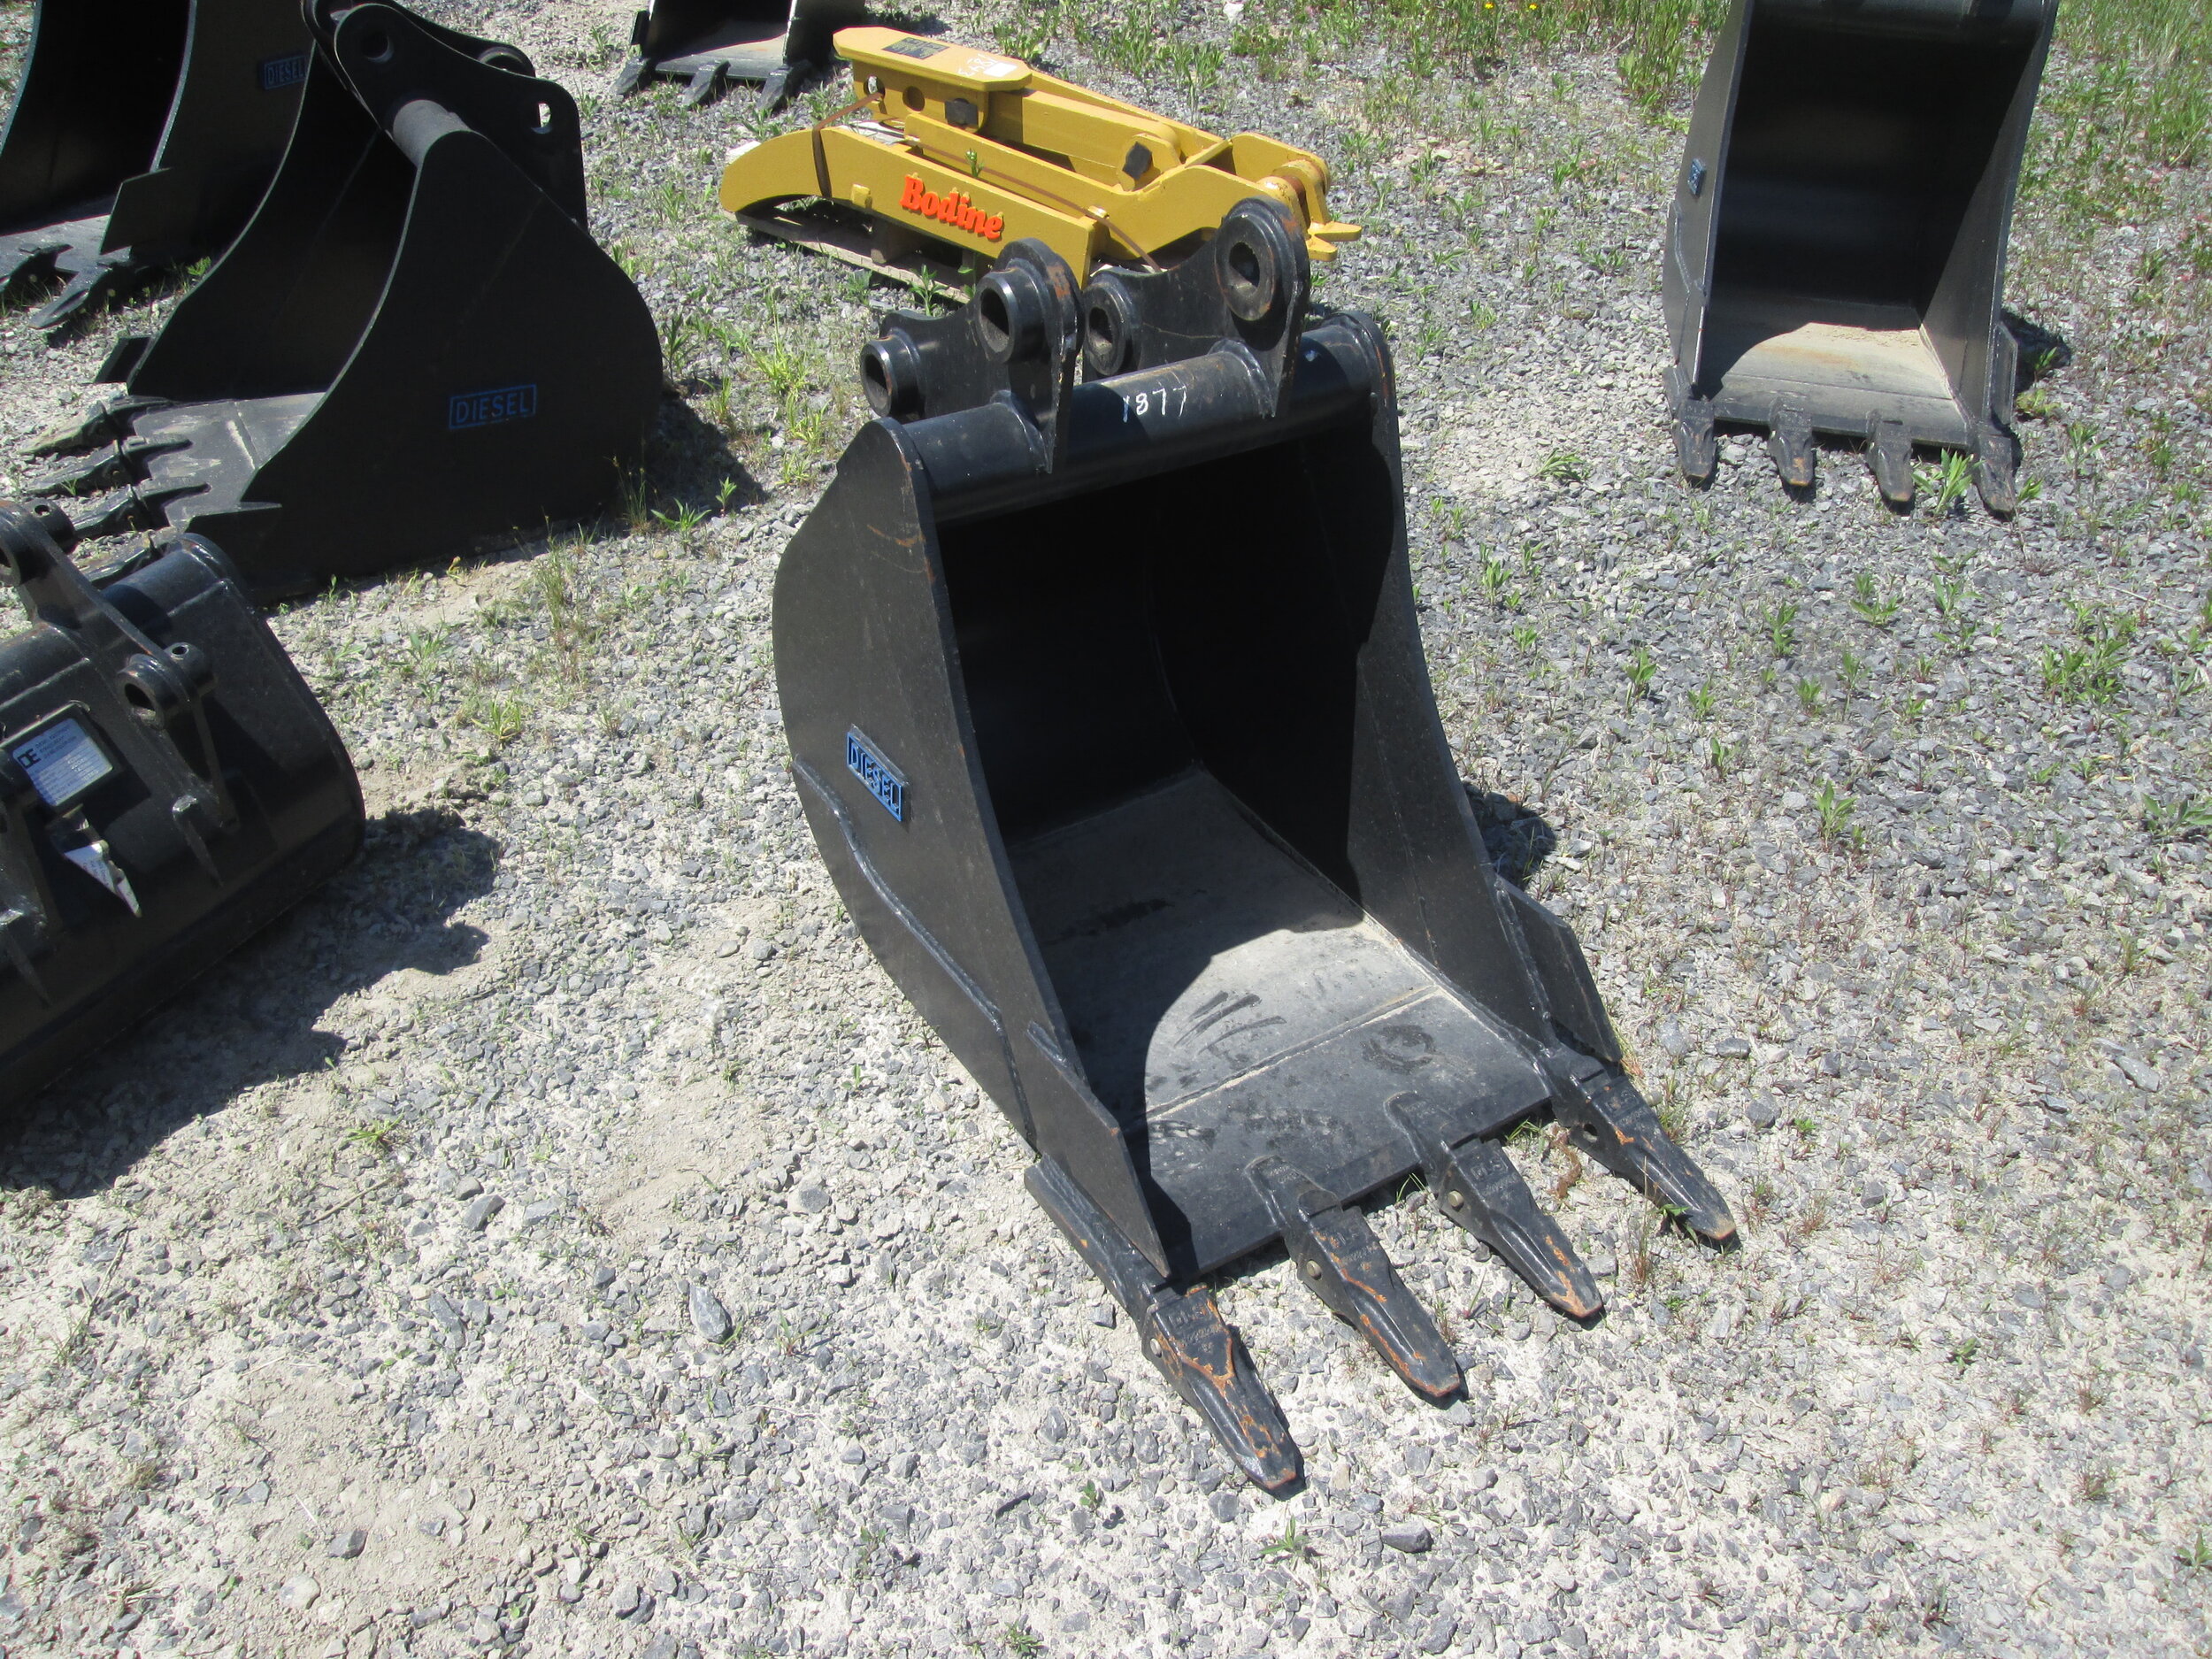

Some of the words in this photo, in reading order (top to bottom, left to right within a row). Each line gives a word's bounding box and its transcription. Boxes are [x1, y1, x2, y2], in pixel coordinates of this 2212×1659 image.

[267, 61, 306, 85] DIESEL
[899, 173, 1004, 239] Bodine
[456, 391, 529, 424] DIESEL
[1122, 385, 1187, 423] 1877
[850, 741, 901, 814] DIESEL
